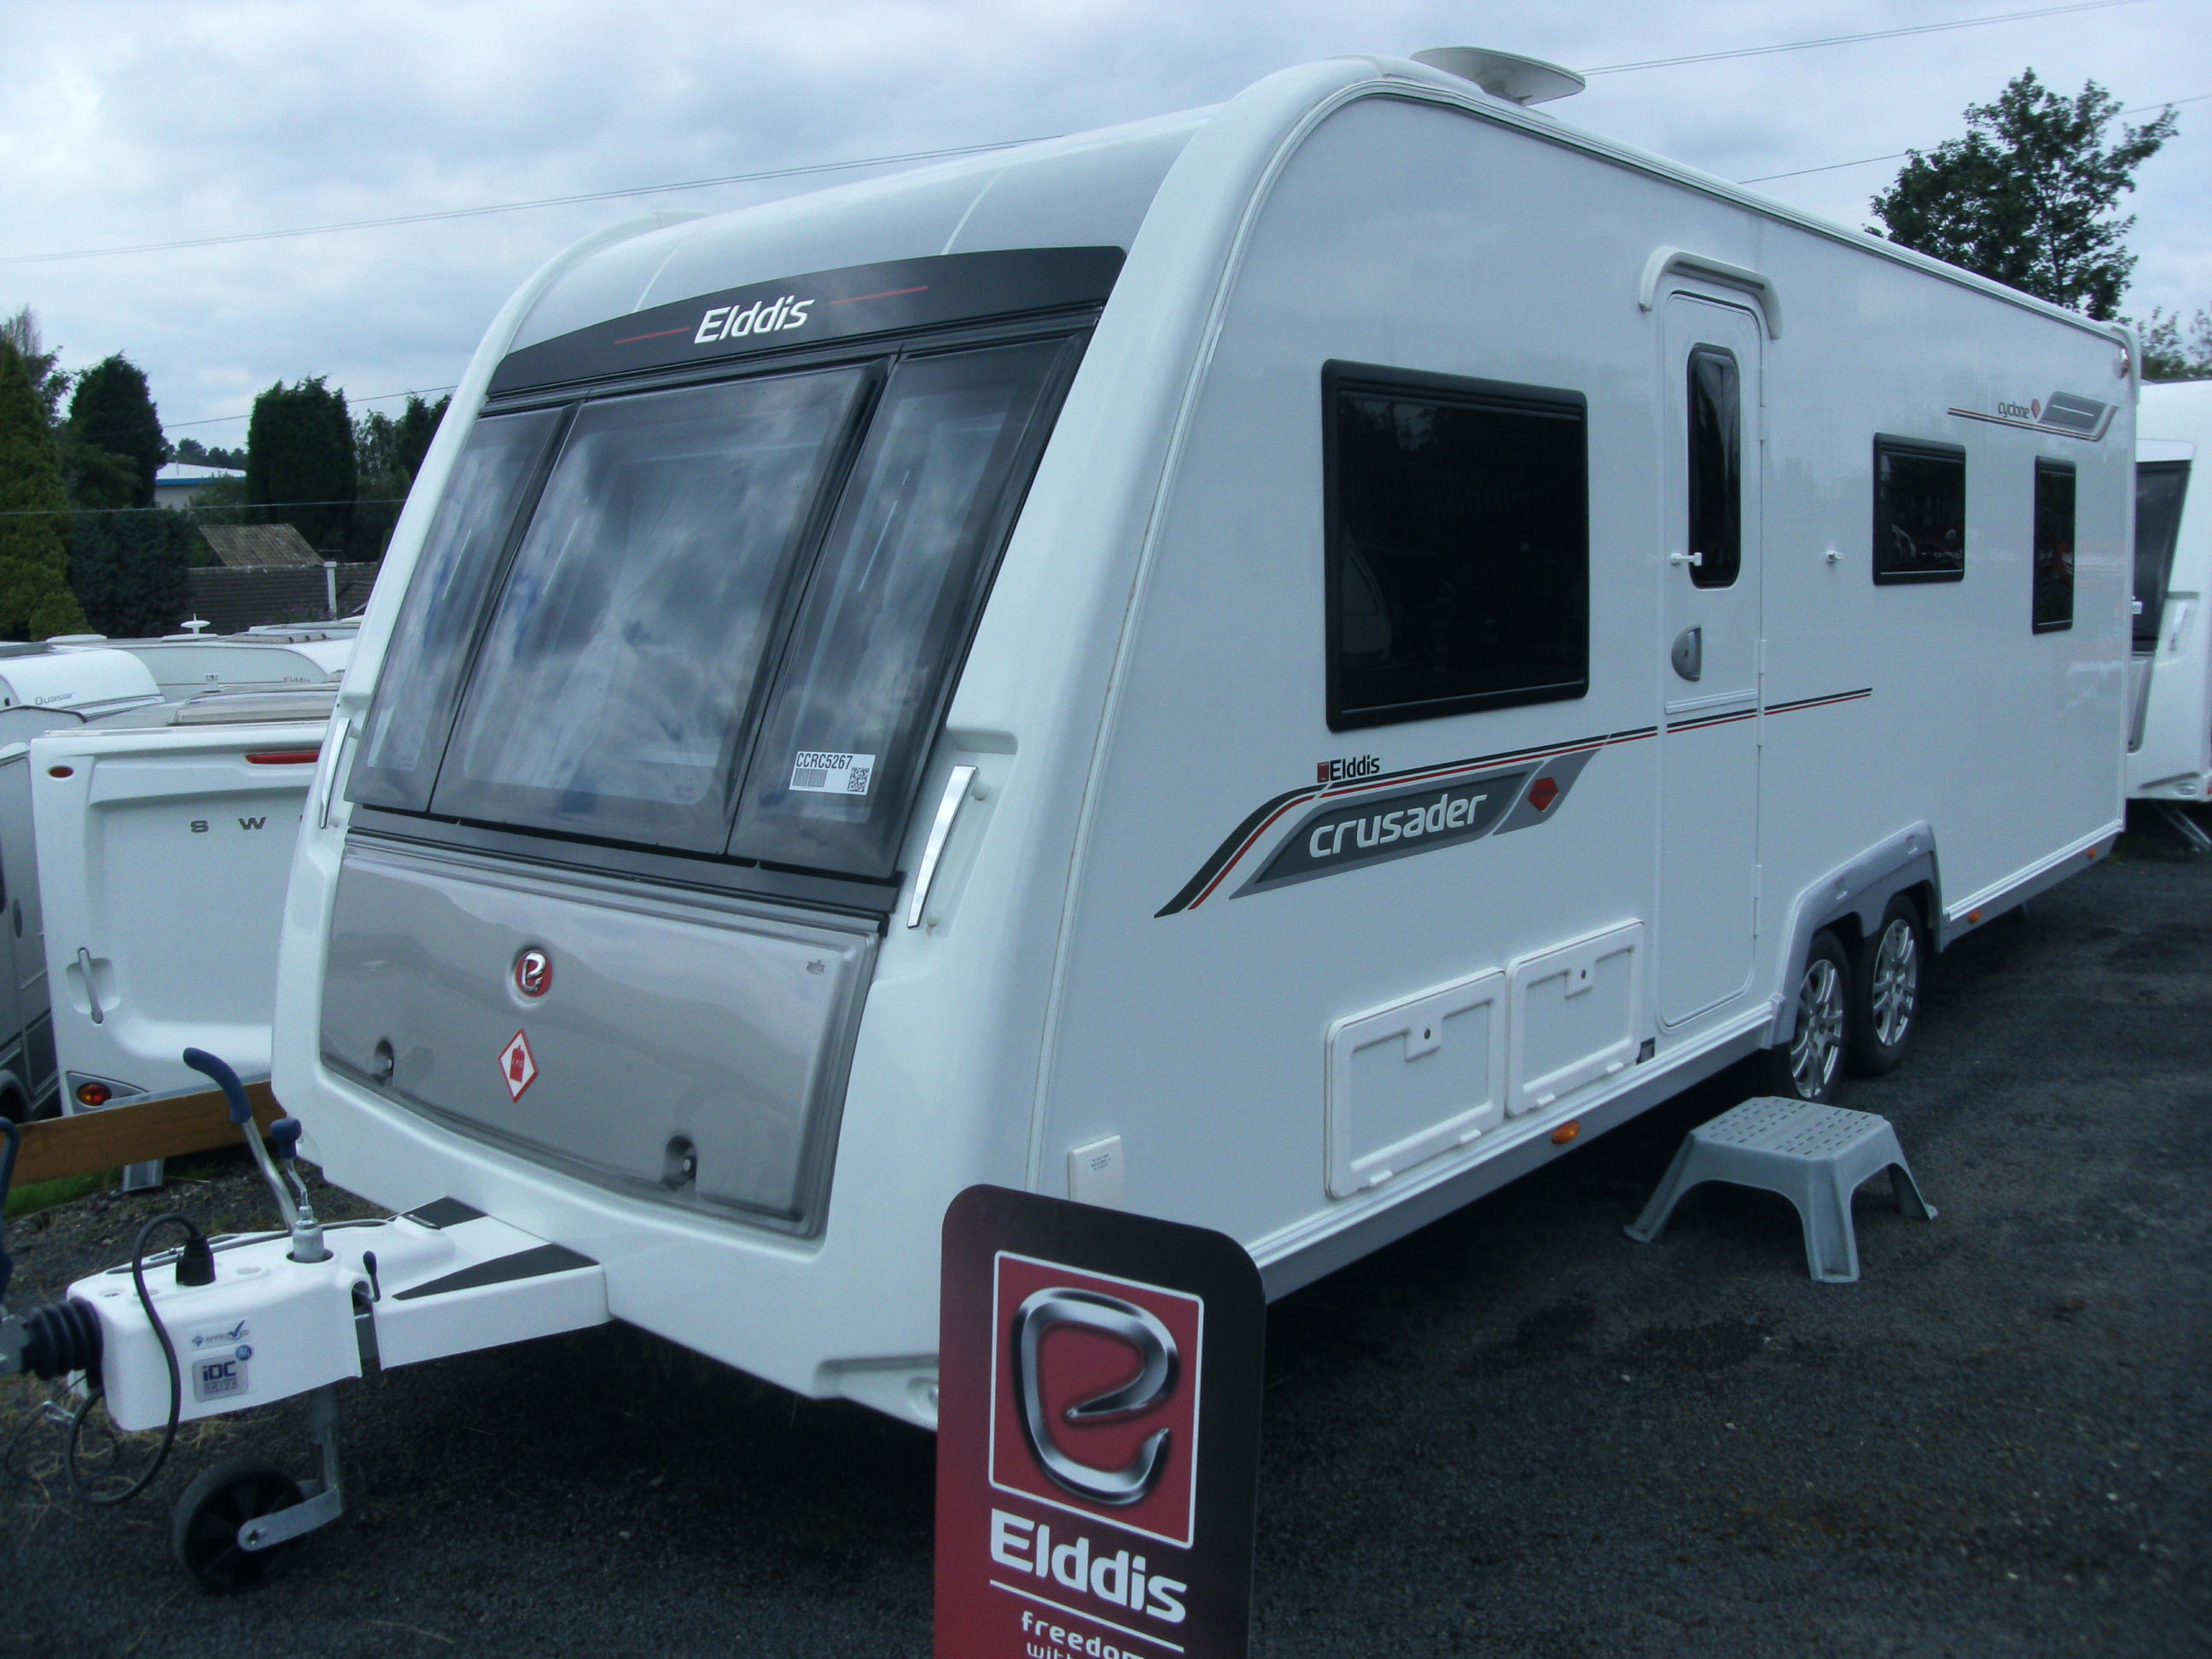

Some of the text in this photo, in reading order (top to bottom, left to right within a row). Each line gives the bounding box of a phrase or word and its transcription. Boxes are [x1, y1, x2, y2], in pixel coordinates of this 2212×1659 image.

[694, 294, 816, 344] Elddis
[1998, 402, 2029, 419] cyclone
[35, 692, 76, 706] Quasar
[796, 753, 853, 769] CCRC5267
[1330, 754, 1380, 781] Elddis
[1309, 793, 1487, 858] crusader
[991, 1507, 1187, 1623] Elddis
[1027, 1641, 1077, 1659] wit
